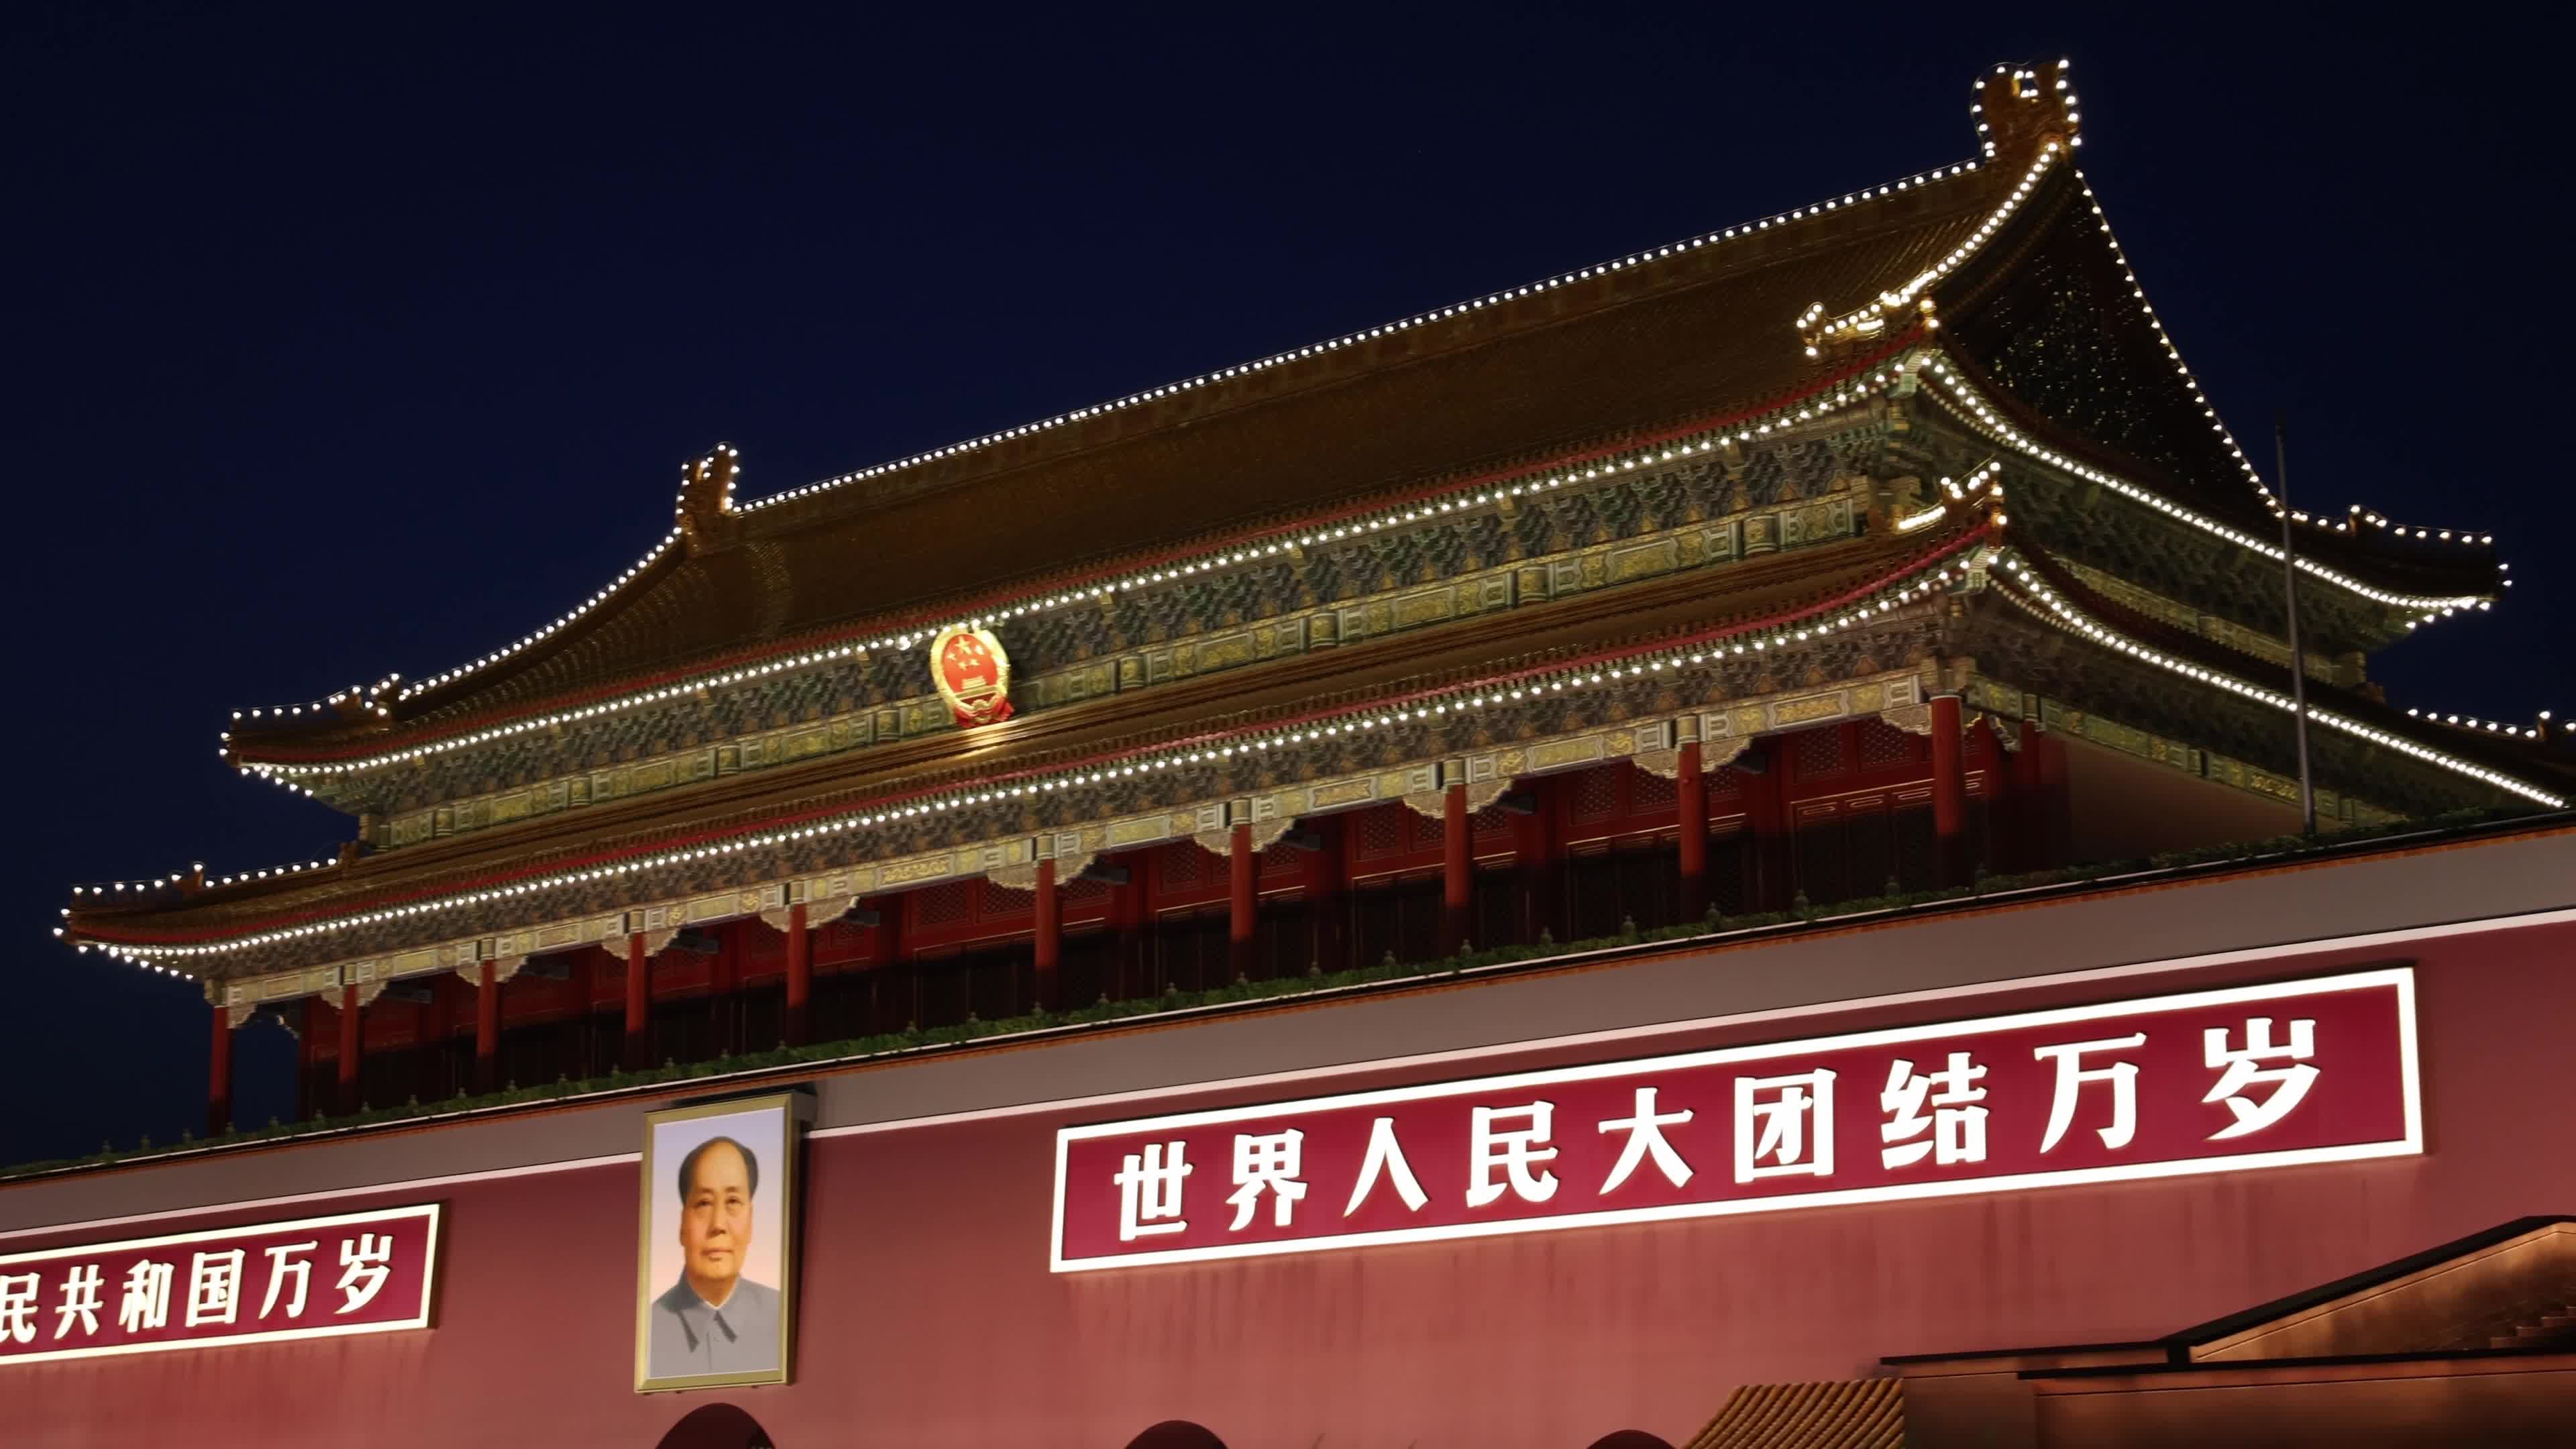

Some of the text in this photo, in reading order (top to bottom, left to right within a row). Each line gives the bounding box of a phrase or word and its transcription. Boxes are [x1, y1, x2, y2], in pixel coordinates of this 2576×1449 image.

[1113, 1017, 2321, 1242] 世界人民大团结万岁
[0, 1233, 393, 1344] 民共和国万岁
